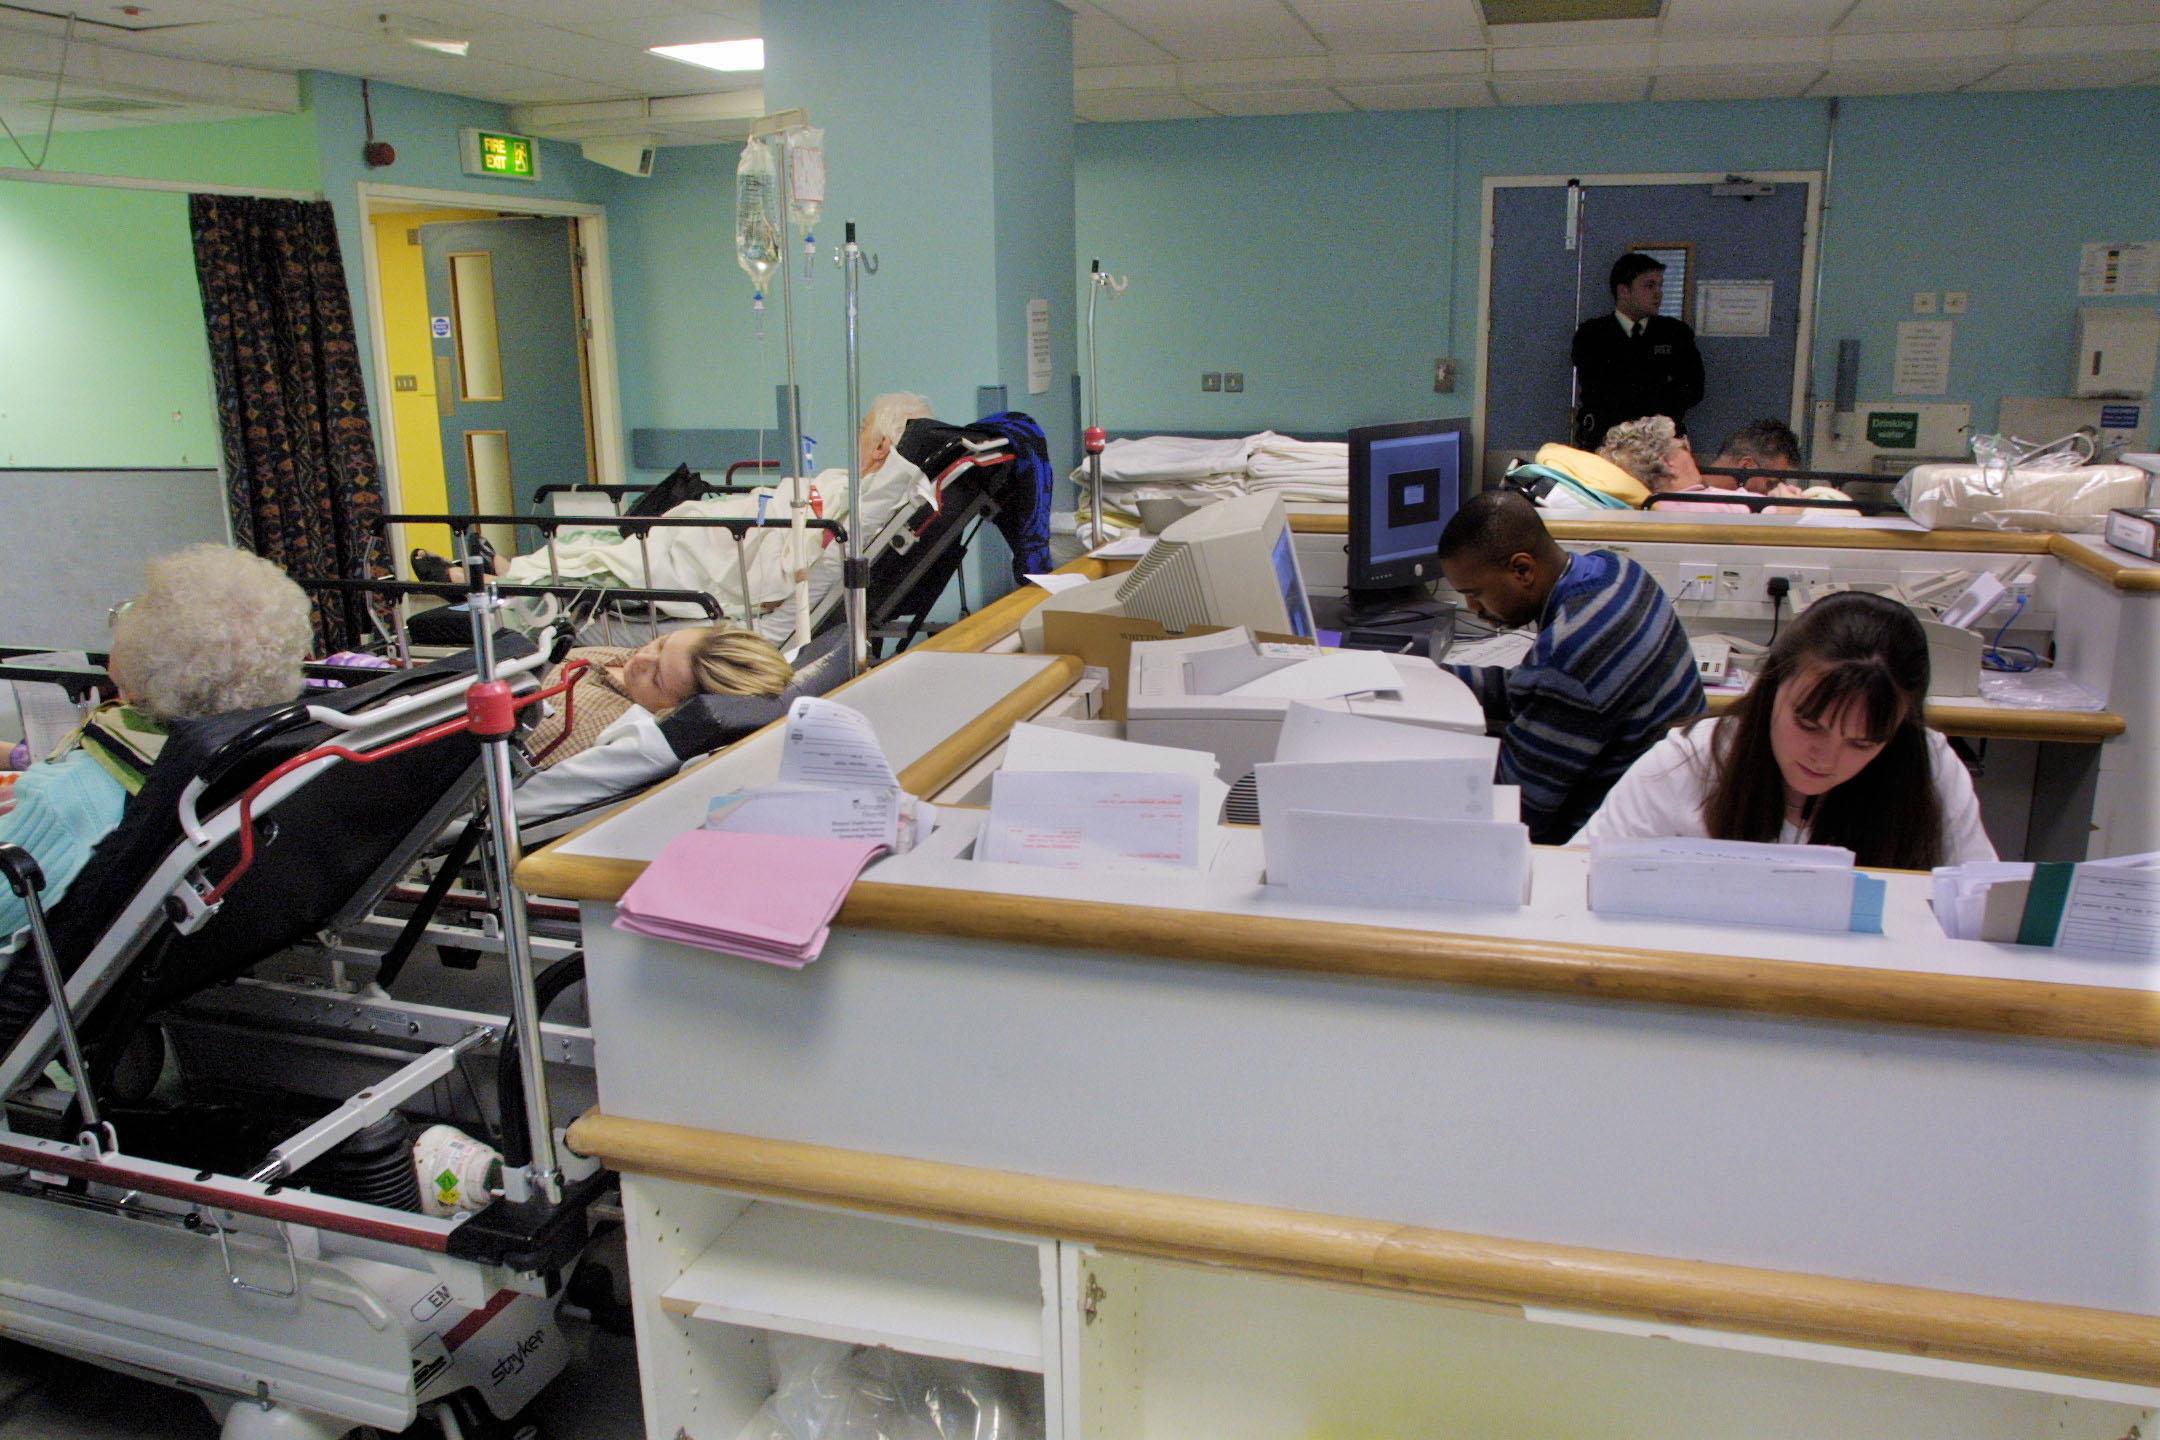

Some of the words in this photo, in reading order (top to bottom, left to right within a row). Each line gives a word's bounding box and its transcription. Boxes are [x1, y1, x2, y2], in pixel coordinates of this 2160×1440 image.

[484, 137, 506, 154] FIRE
[485, 153, 507, 170] EXIT
[1872, 419, 1913, 430] Drinking
[491, 1330, 544, 1387] stryker
